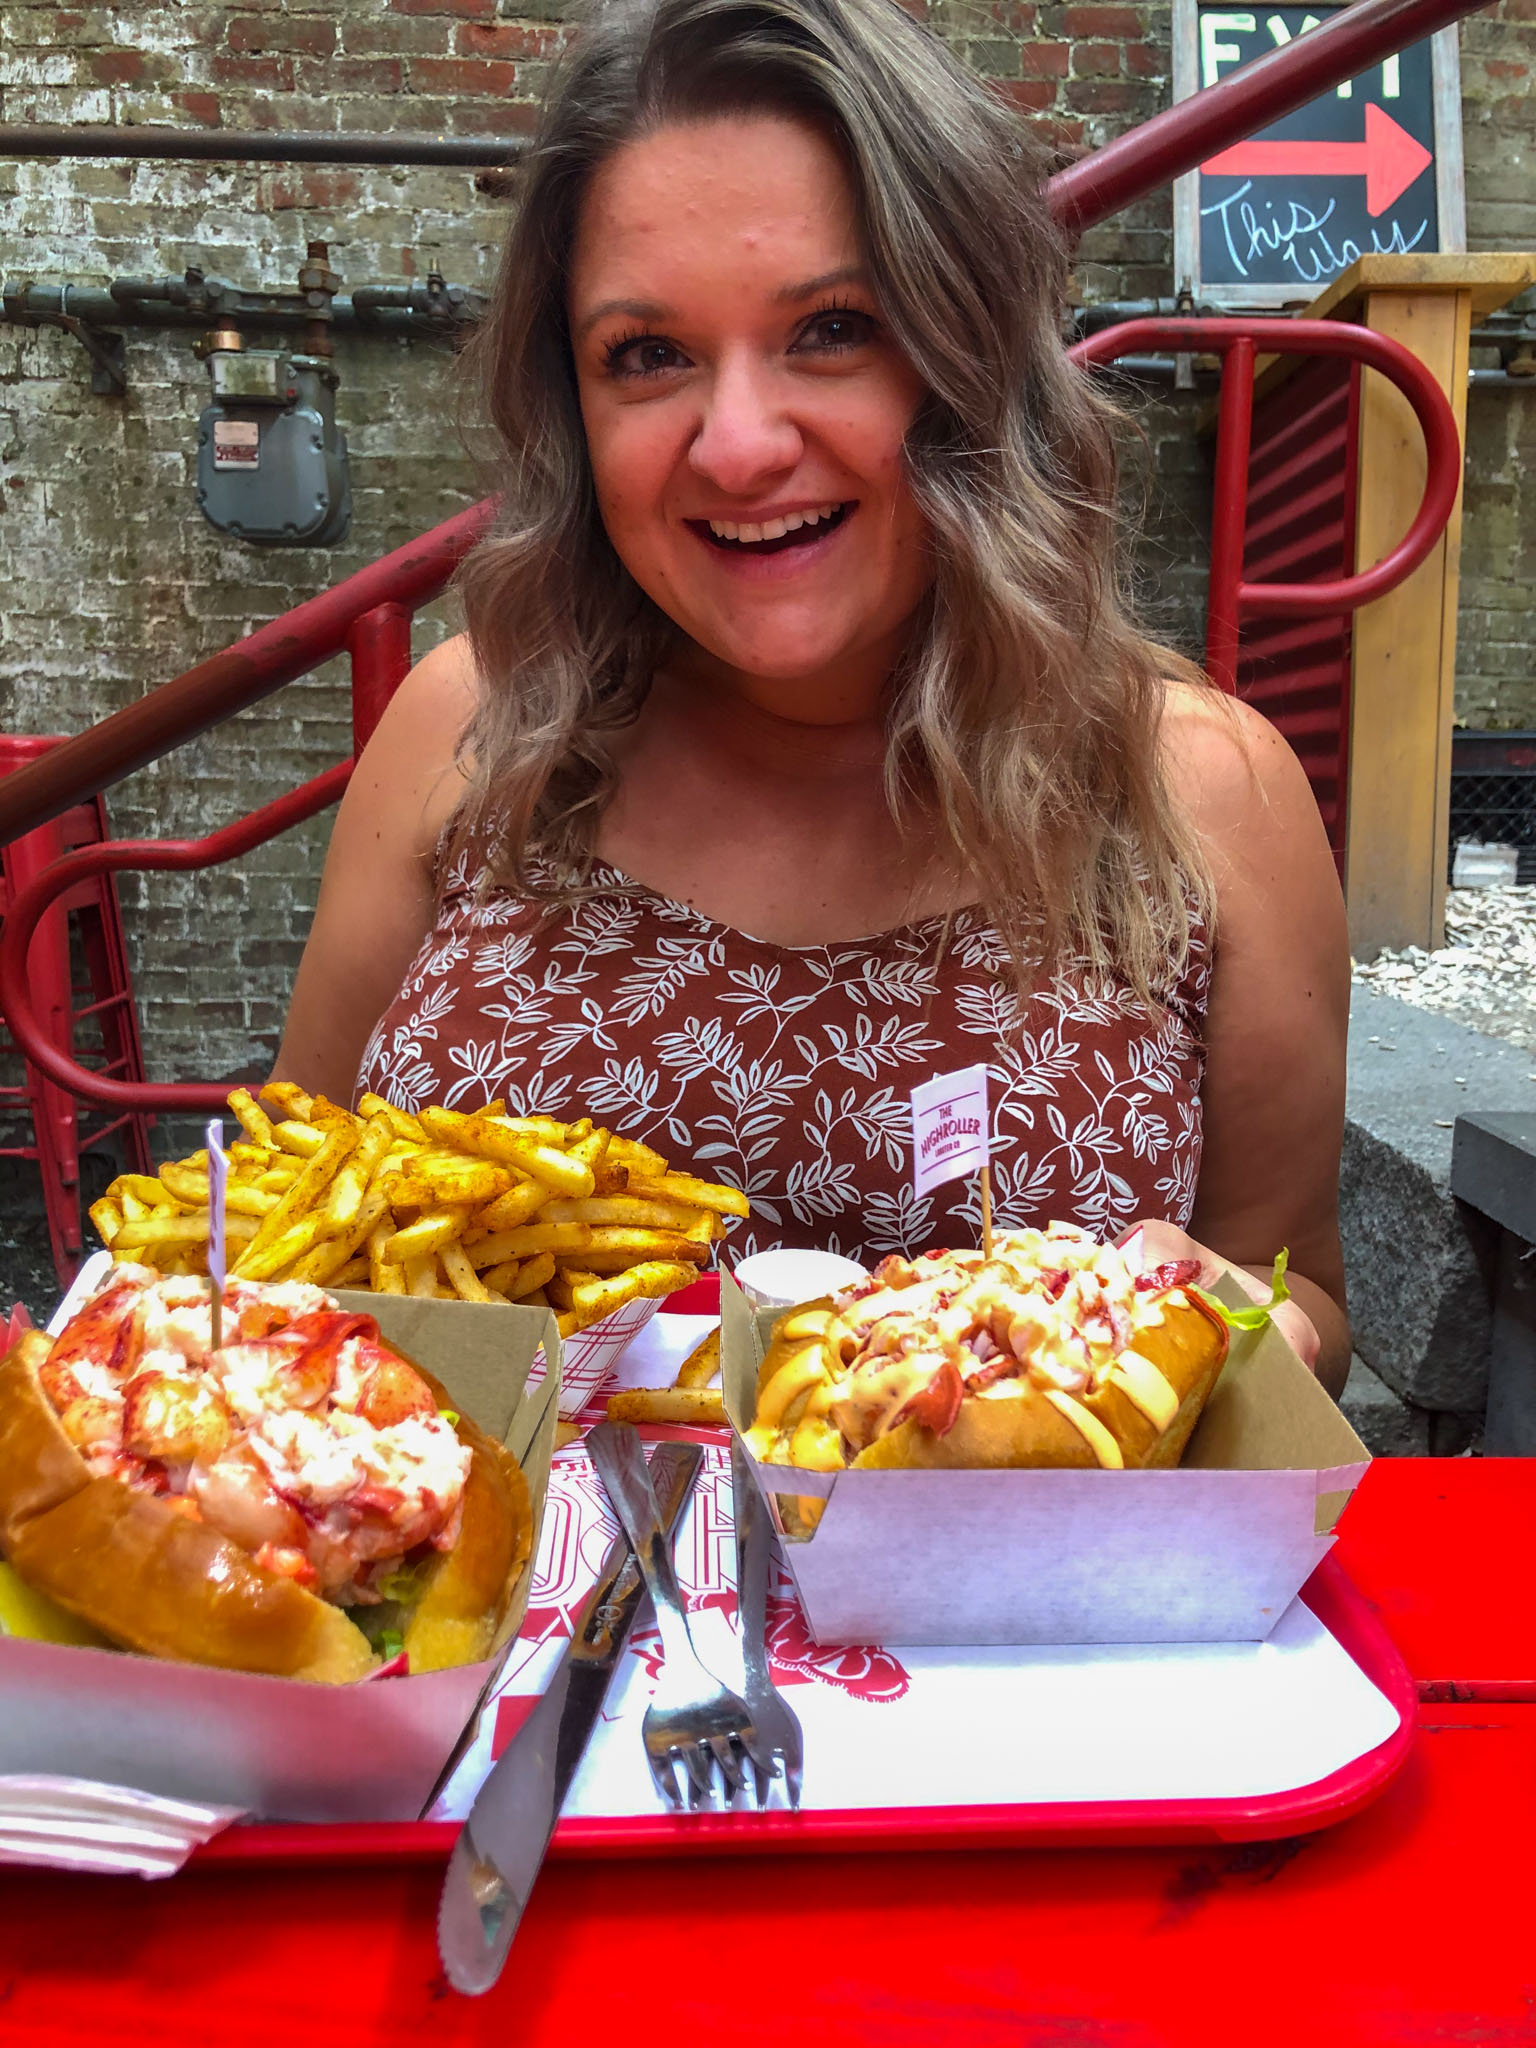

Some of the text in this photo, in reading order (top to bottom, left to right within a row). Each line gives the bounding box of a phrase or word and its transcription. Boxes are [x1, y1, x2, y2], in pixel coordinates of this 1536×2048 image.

[1201, 180, 1336, 276] This
[939, 1105, 952, 1119] THE
[920, 1117, 980, 1159] HIGHROLLER
